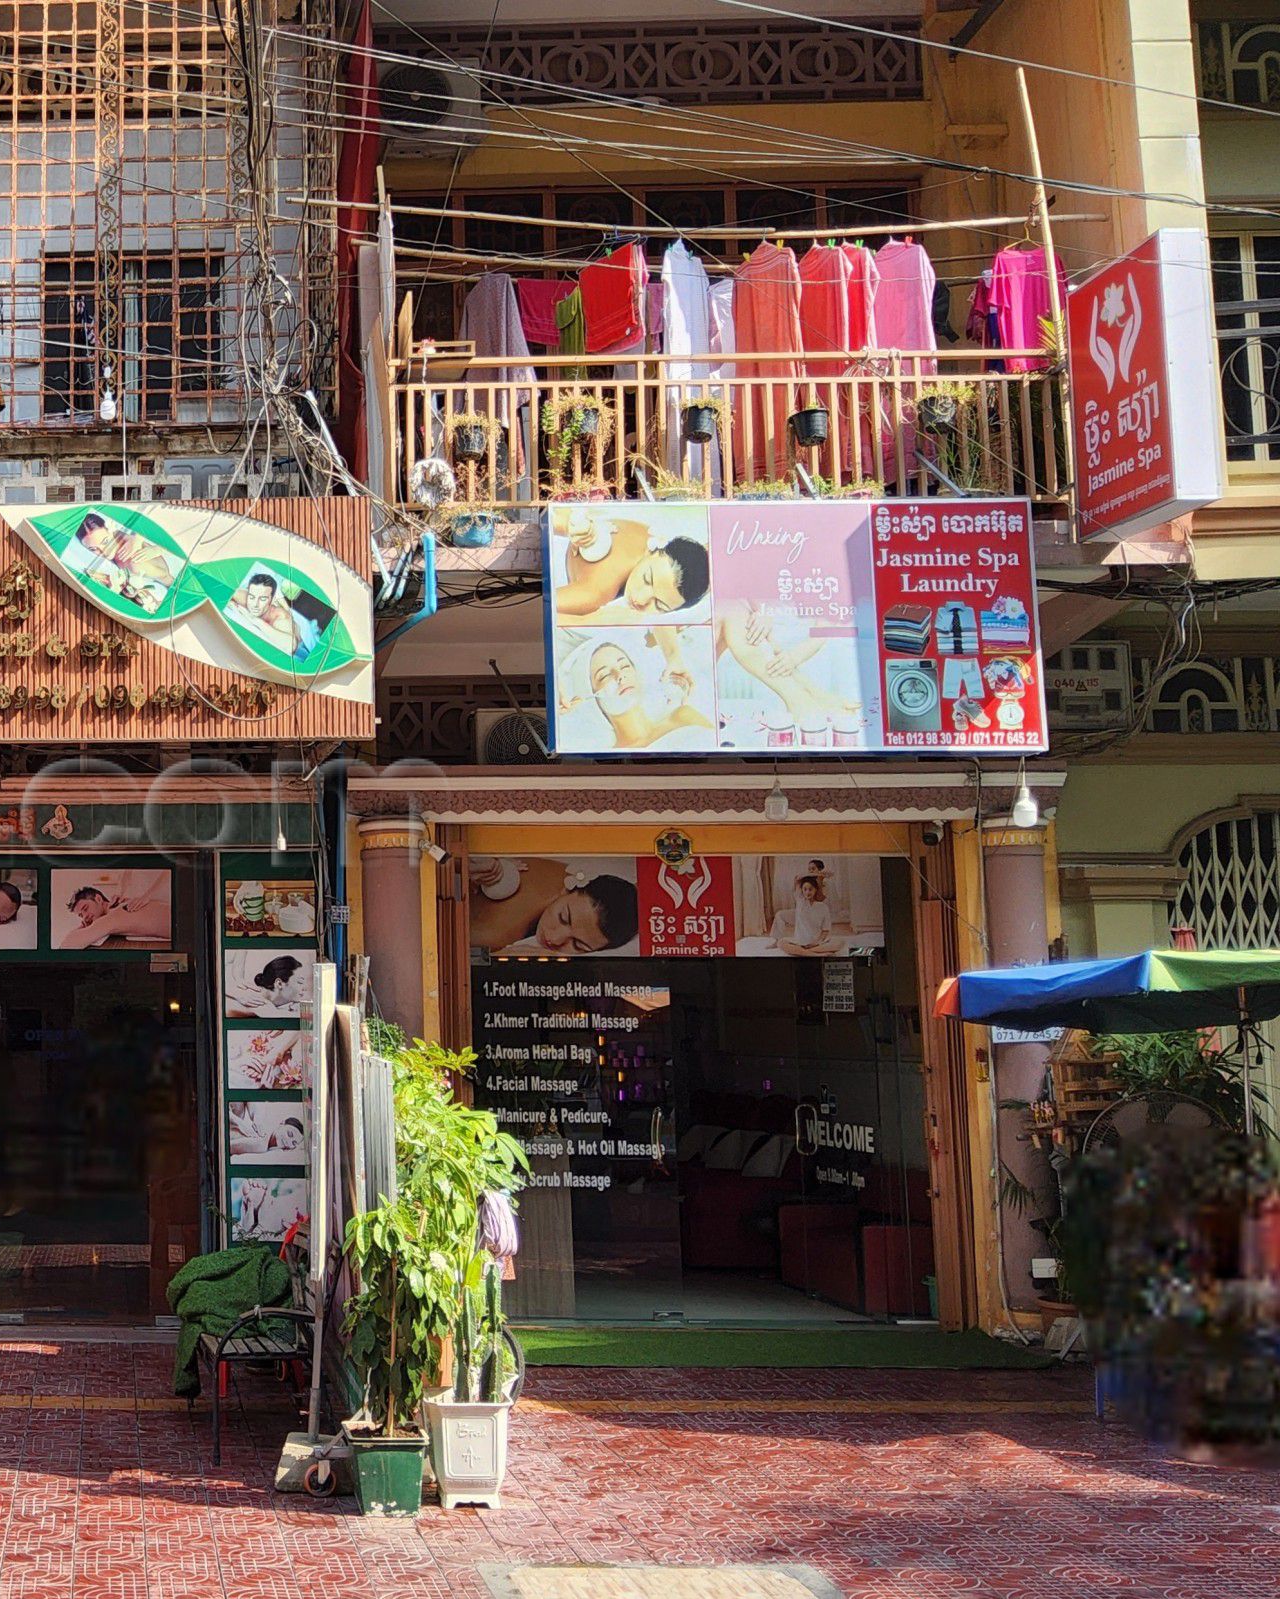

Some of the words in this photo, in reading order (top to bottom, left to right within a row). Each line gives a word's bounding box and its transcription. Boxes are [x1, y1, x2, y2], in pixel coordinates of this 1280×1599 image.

[1087, 456, 1135, 497] Jasmine
[1137, 443, 1162, 470] Spa
[726, 520, 809, 564] Waxing
[876, 548, 971, 567] Jasmine
[978, 547, 1020, 573] Spa
[900, 573, 999, 598] Laundry
[758, 602, 824, 616] Jasmine
[829, 602, 857, 620] Spa
[46, 632, 70, 659] &
[80, 632, 140, 658] SPA
[33, 685, 67, 710] 98
[94, 684, 146, 710] 096
[886, 732, 905, 744] Tel:
[906, 732, 924, 744] 012
[926, 732, 938, 744] 98
[940, 732, 952, 744] 30
[954, 732, 966, 744] 79
[973, 732, 990, 744] 071
[992, 732, 1004, 744] 77
[1007, 732, 1025, 744] 645
[1026, 732, 1039, 744] 22
[650, 944, 699, 957] Jasmine
[702, 944, 725, 957] Spa
[483, 981, 516, 997] 1.Foot
[520, 981, 601, 1000] Massage&Head
[484, 1013, 529, 1029] 2.Khmer
[531, 1013, 589, 1029] Traditional
[592, 1013, 639, 1032] Massage
[996, 1031, 1014, 1041] 071
[485, 1044, 530, 1060] 3.Aroma
[532, 1044, 567, 1060] Herbal
[570, 1044, 592, 1064] Bag
[486, 1075, 528, 1091] 4.Facial
[531, 1075, 578, 1096] Massage
[550, 1107, 558, 1124] &
[561, 1107, 612, 1126] Pedicure,
[806, 1118, 875, 1154] WELCOME
[567, 1140, 575, 1155] &
[578, 1140, 597, 1155] Hot
[600, 1140, 615, 1155] Oil
[618, 1140, 666, 1159] Massage
[529, 1171, 561, 1188] Scrub
[563, 1171, 611, 1191] Massage
